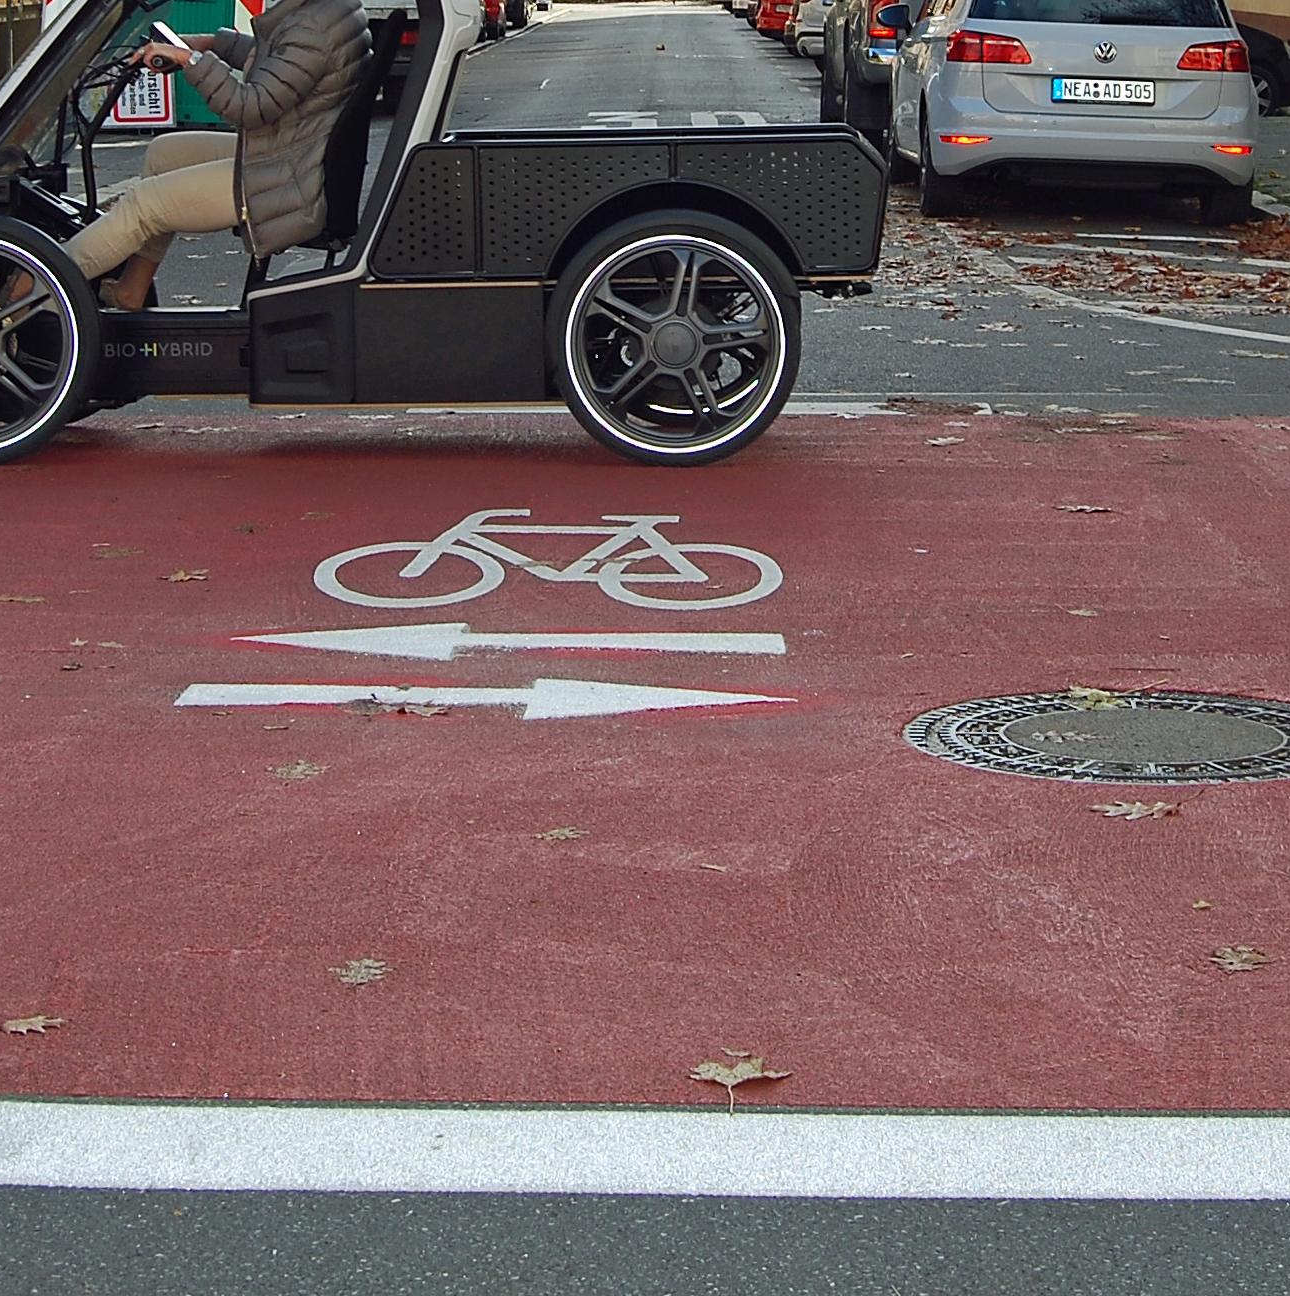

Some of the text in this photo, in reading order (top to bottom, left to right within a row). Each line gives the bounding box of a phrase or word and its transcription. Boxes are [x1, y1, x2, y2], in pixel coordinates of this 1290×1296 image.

[147, 71, 161, 115] orsicht!
[1063, 81, 1152, 100] NEA AD 505
